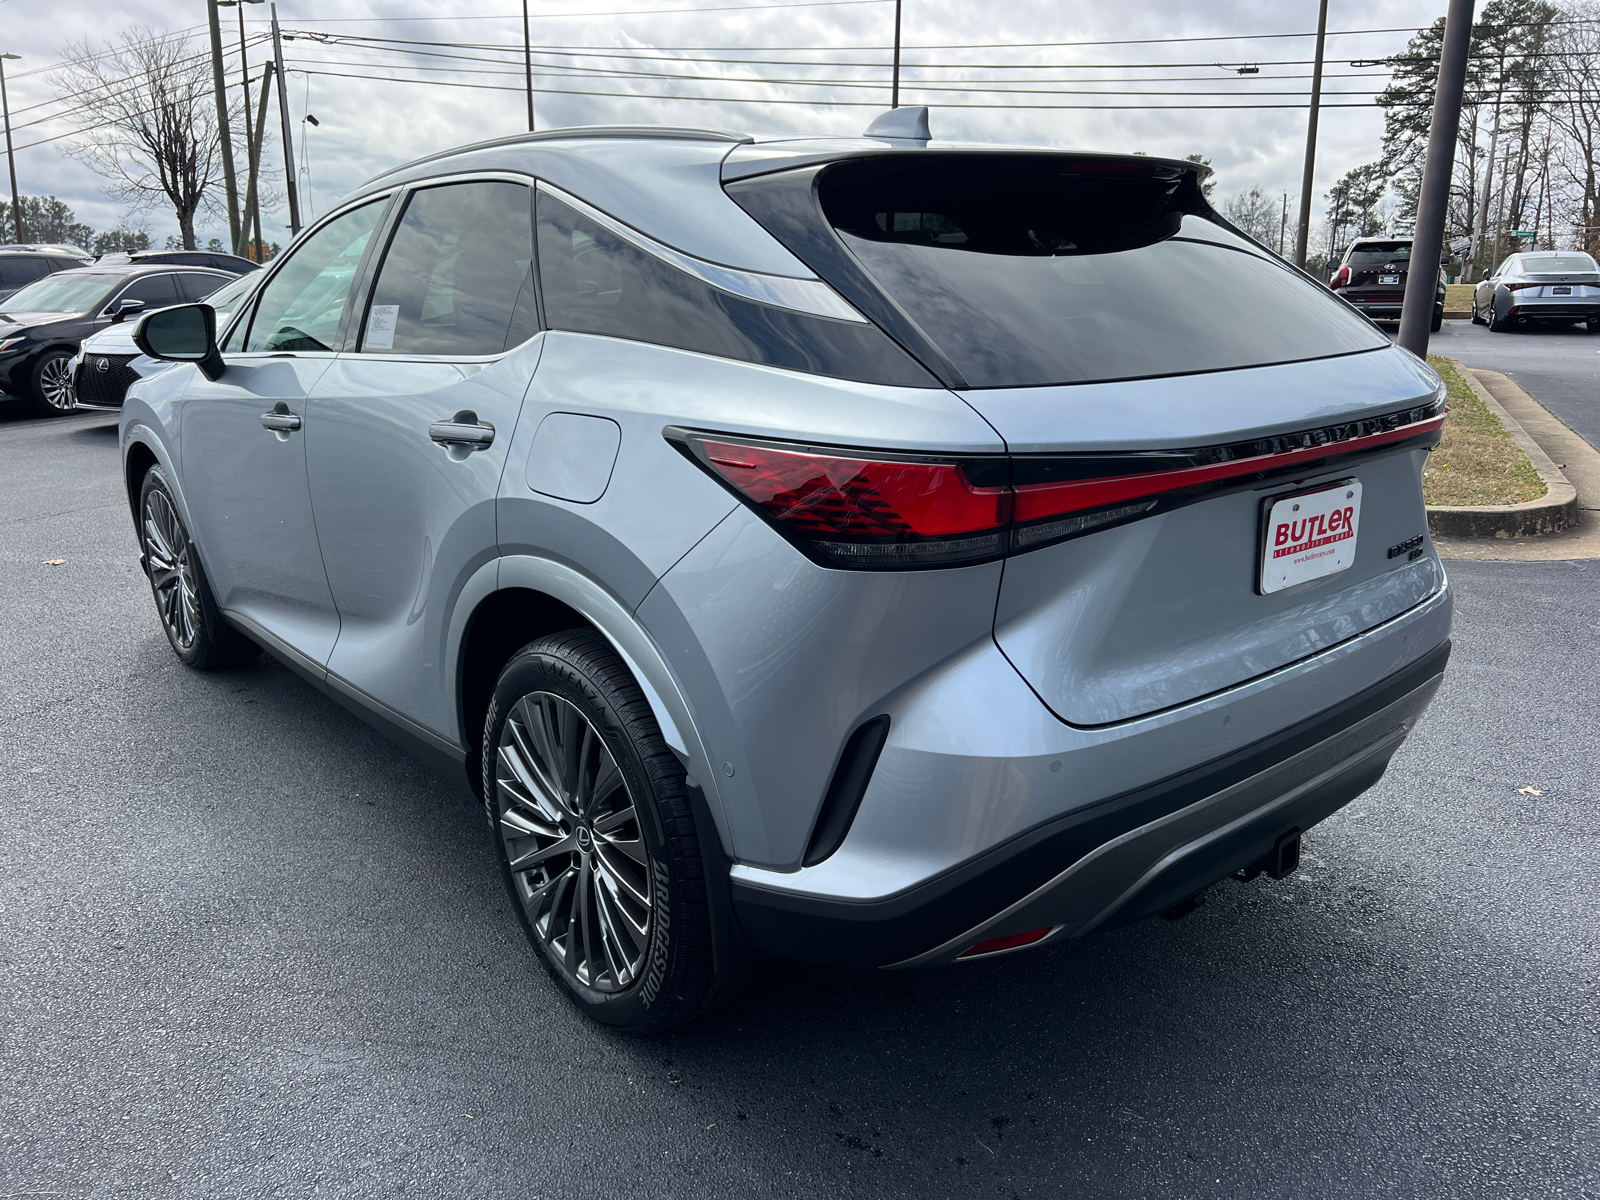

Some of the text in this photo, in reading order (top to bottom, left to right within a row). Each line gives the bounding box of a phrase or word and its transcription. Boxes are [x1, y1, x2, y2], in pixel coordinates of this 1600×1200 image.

[1273, 530, 1354, 558] AUTOMOTIVE GROUP
[1293, 548, 1336, 564] www.butlercars.com
[548, 662, 606, 721] ALENZA
[481, 693, 498, 830] BRIDGESTONE
[642, 857, 671, 1010] BRIDGESTONE
